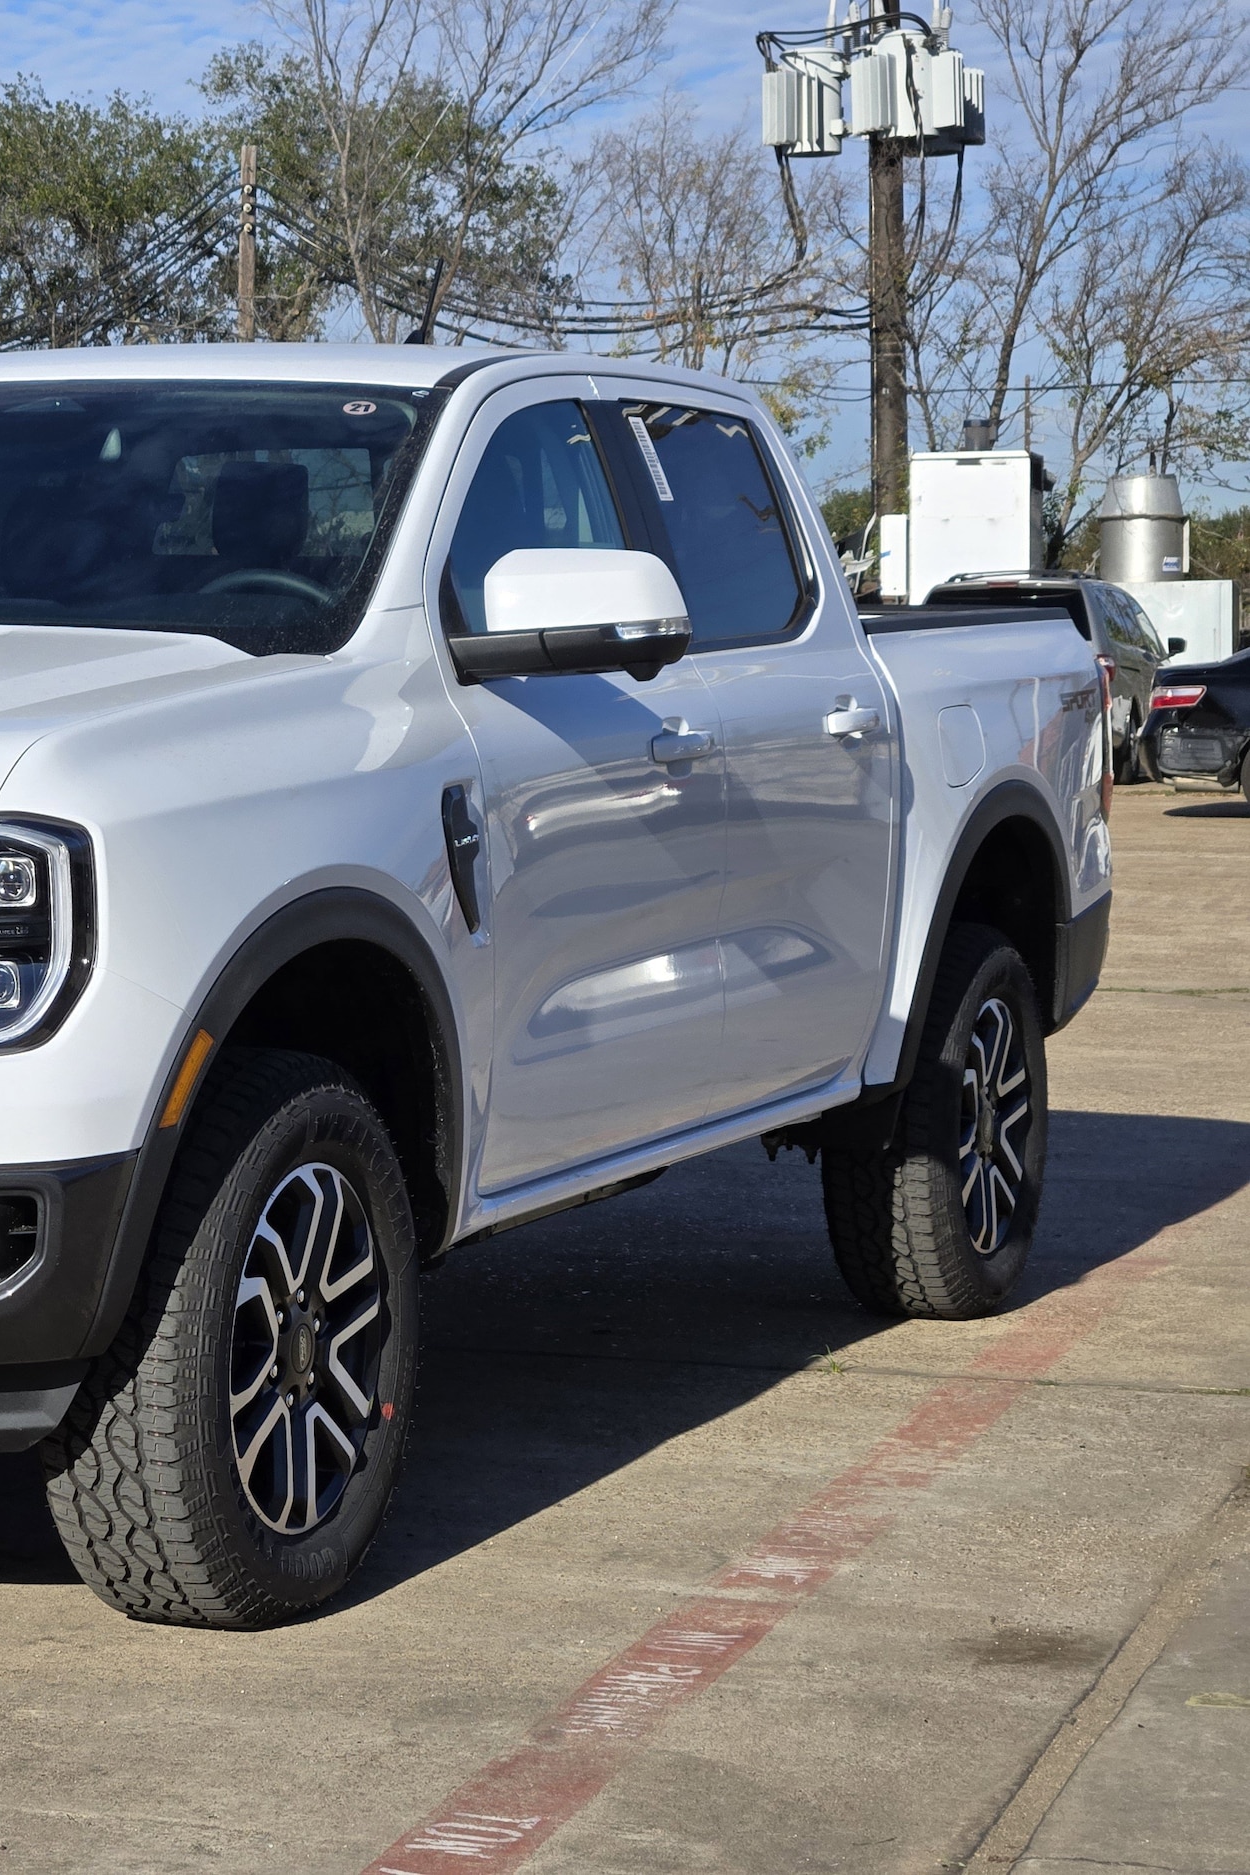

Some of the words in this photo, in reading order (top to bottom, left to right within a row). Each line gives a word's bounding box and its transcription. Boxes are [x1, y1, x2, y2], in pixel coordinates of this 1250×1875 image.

[348, 402, 372, 413] 21
[1060, 688, 1097, 713] SPORT
[645, 1628, 745, 1654] NO
[404, 1811, 543, 1860] TOW
